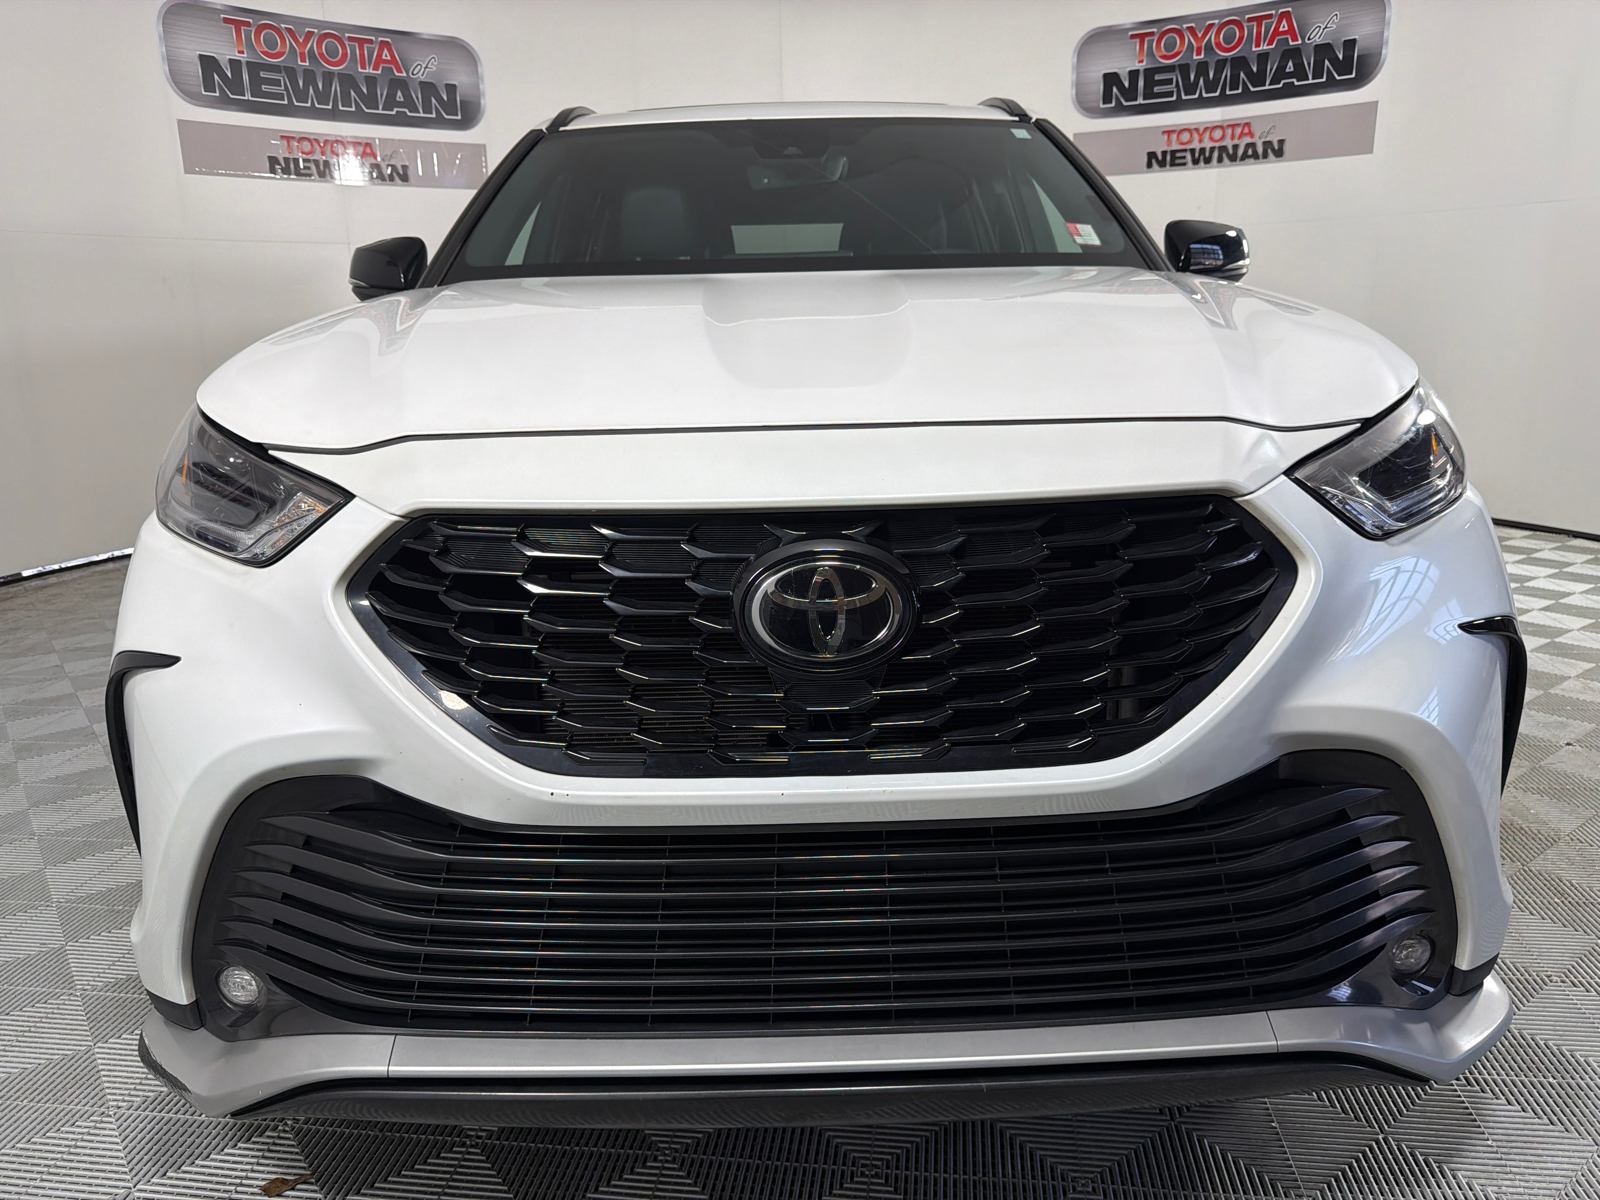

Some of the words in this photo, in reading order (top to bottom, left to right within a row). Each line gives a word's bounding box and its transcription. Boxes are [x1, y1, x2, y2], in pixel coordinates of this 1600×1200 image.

[221, 15, 406, 76] TOYOTA
[409, 55, 437, 79] of
[1129, 8, 1301, 65] TOYOTA
[1305, 12, 1339, 43] of
[198, 52, 462, 120] NEWNAN
[1101, 37, 1358, 108] NEWNAN
[280, 134, 378, 161] TOYOTA
[1146, 138, 1286, 170] NEWNAN
[1162, 121, 1256, 148] TOYOTA
[1258, 124, 1277, 140] of
[267, 155, 410, 183] NEWAN
